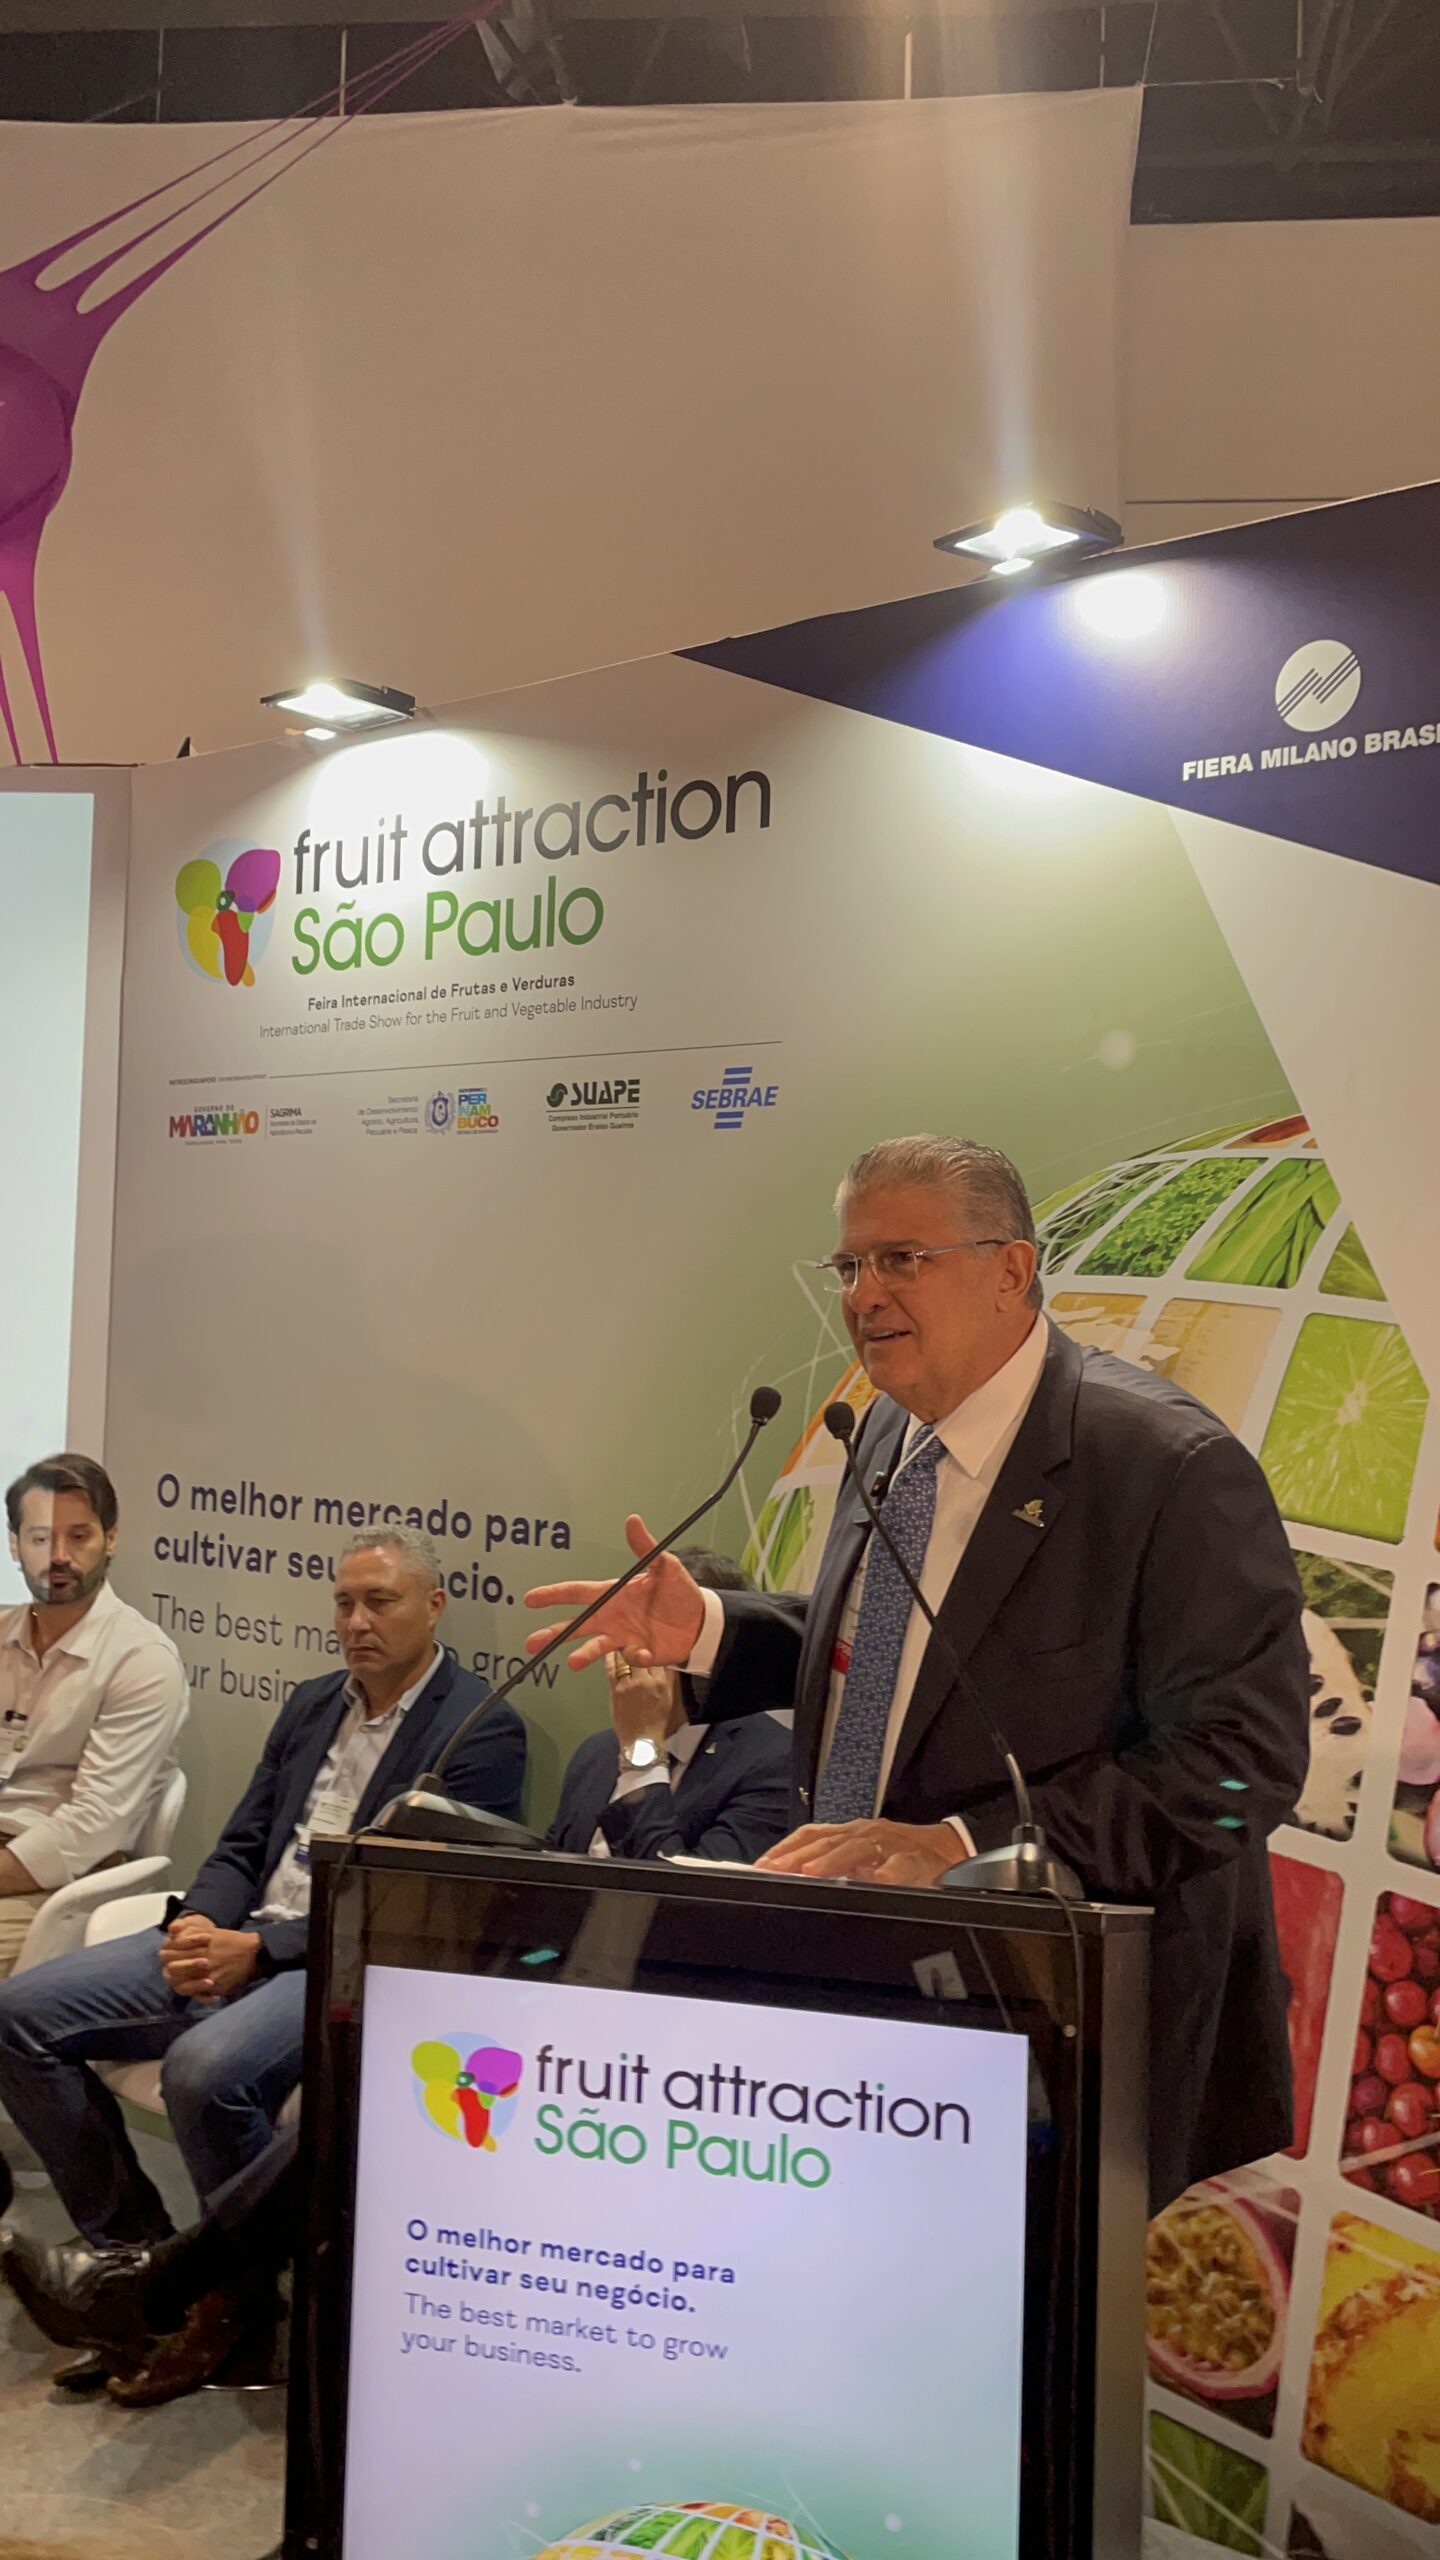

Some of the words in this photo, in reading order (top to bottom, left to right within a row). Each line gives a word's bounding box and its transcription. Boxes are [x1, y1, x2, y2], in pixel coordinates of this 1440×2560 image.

[1182, 753, 1254, 782] FIERA
[1261, 736, 1357, 769] MILANO
[1364, 722, 1440, 755] BRASI
[293, 814, 408, 895] fruit
[422, 768, 772, 877] attraction
[291, 900, 404, 975] São
[424, 875, 605, 960] Paulo
[260, 1019, 331, 1038] International
[334, 1017, 366, 1033] Trade
[369, 1014, 402, 1029] Show
[406, 1012, 423, 1026] for
[426, 1010, 447, 1024] the
[451, 1006, 481, 1022] Fruit
[484, 1003, 508, 1019] and
[511, 998, 577, 1020] Vegetable
[581, 994, 638, 1012] Industry
[308, 997, 338, 1011] Feira
[342, 987, 427, 1009] Internacional
[430, 985, 447, 999] de
[451, 982, 496, 998] Frutas
[500, 982, 508, 993] e
[512, 975, 576, 991] Verduras
[458, 1093, 487, 1106] PER
[458, 1104, 491, 1116] NAM
[571, 1079, 640, 1106] SUAPE
[691, 1085, 779, 1110] SEBRAE
[168, 1109, 260, 1138] MARANHÃO
[457, 1115, 499, 1129] BUCO
[157, 1473, 180, 1508] O
[191, 1481, 303, 1520] melhor
[314, 1498, 472, 1539] mercado
[485, 1517, 571, 1552] para
[154, 1530, 277, 1574] cultivar
[152, 1593, 205, 1634] The
[216, 1602, 283, 1646] best
[536, 2044, 650, 2103] fruit
[663, 2063, 970, 2144] attraction
[534, 2103, 648, 2165] São
[666, 2118, 832, 2188] Paulo
[407, 2219, 428, 2241] O
[436, 2228, 532, 2255] melhor
[540, 2240, 664, 2274] mercado
[672, 2260, 736, 2285] para
[405, 2255, 511, 2286] cultivar
[519, 2272, 568, 2295] seu
[576, 2280, 696, 2313] negócio.
[404, 2291, 452, 2319] The
[459, 2300, 518, 2329] best
[526, 2315, 618, 2345] market
[626, 2328, 656, 2350] to
[663, 2336, 729, 2361] grow
[400, 2331, 457, 2354] your
[464, 2334, 582, 2373] business.
